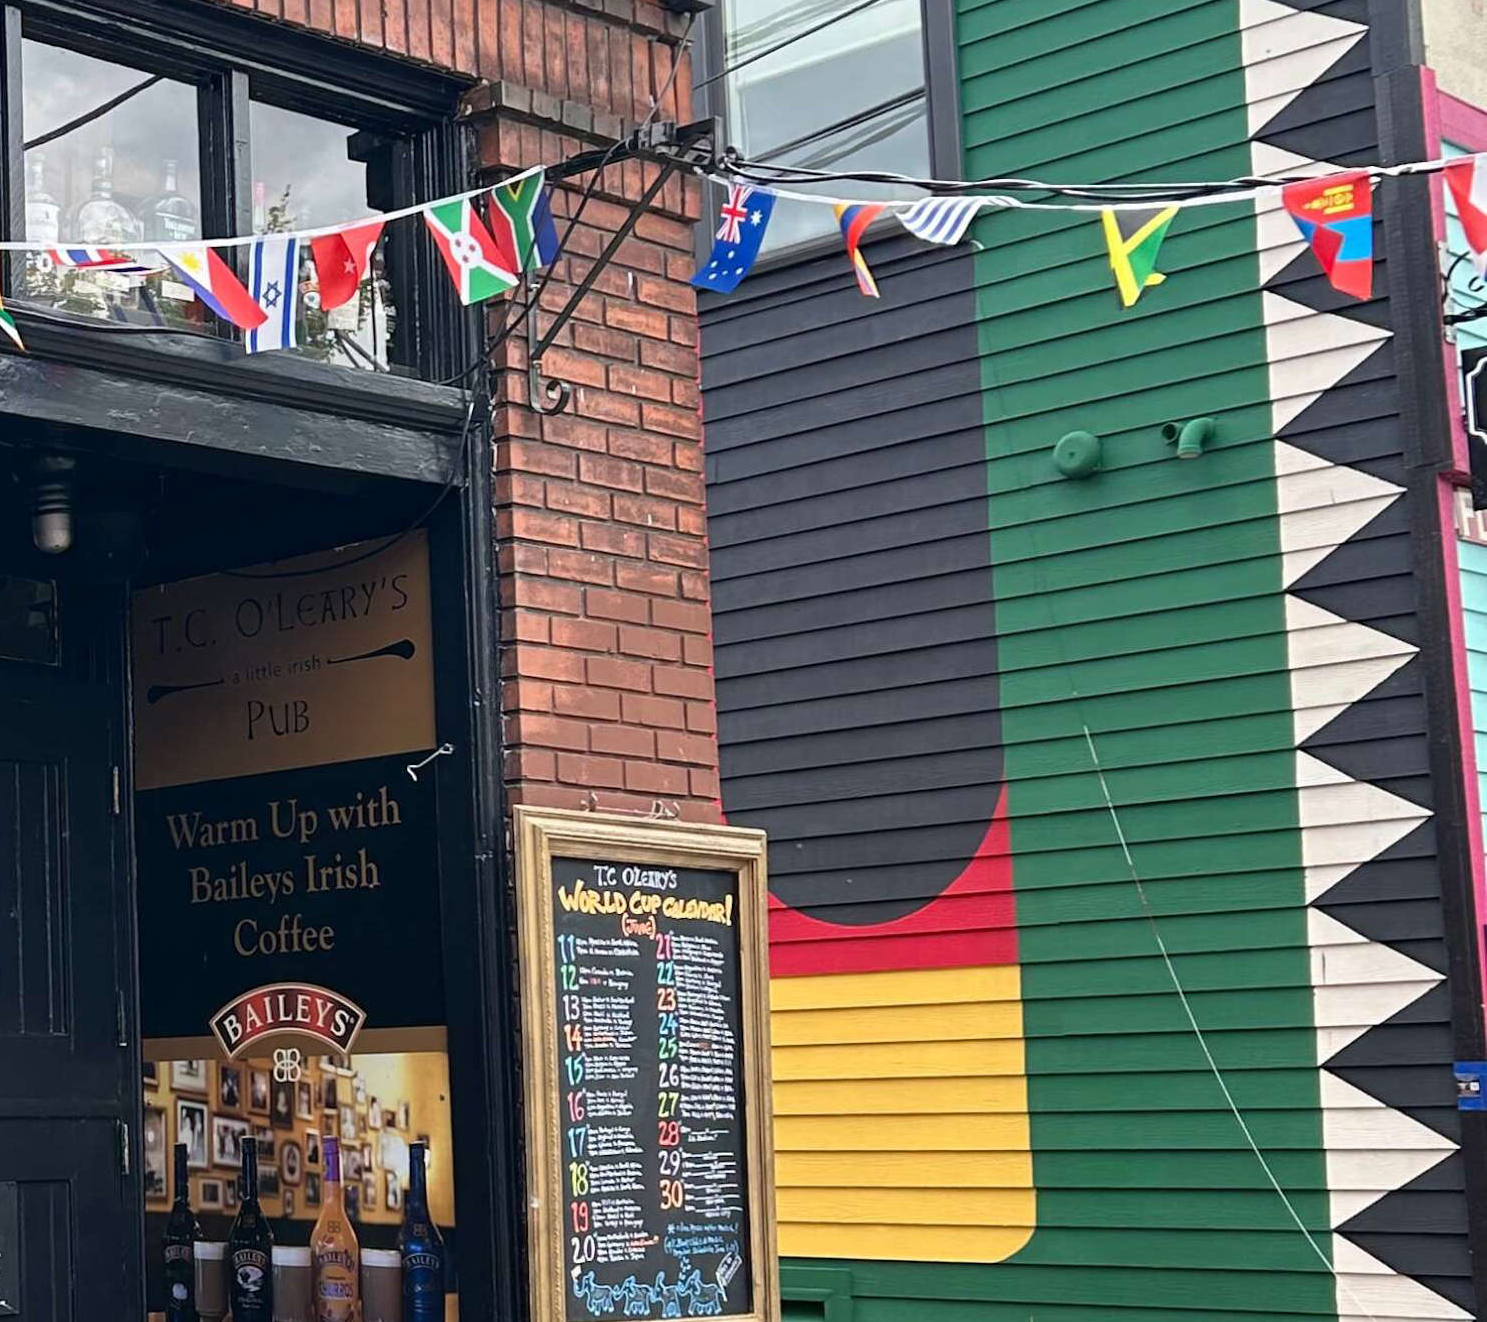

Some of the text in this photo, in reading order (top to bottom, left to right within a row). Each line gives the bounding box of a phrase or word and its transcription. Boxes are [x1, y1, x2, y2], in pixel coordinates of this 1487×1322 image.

[235, 574, 408, 638] O'LEARY'S
[232, 653, 322, 684] a little irish
[247, 699, 310, 740] PUB
[166, 785, 402, 851] Warm Up with
[188, 847, 381, 904] Baileys Irish
[558, 879, 627, 915] WORLD
[628, 890, 662, 915] CUP
[233, 913, 335, 957] Coffee
[558, 934, 575, 963] 11
[656, 933, 671, 959] 21
[561, 964, 579, 991] 12
[657, 962, 674, 985] 22
[563, 995, 580, 1021] 13
[658, 988, 676, 1011] 23
[222, 993, 351, 1046] BAILEYS
[658, 1014, 678, 1035] 24
[564, 1024, 583, 1051] 14
[659, 1037, 678, 1059] 25
[565, 1056, 583, 1086] 15
[659, 1062, 679, 1088] 26
[568, 1091, 585, 1122] 16
[658, 1092, 679, 1118] 27
[568, 1128, 586, 1157] 17
[658, 1121, 680, 1146] 28
[659, 1150, 680, 1176] 29
[569, 1162, 589, 1197] 18
[660, 1179, 683, 1210] 30
[571, 1202, 589, 1233] 19
[571, 1235, 596, 1264] 20
